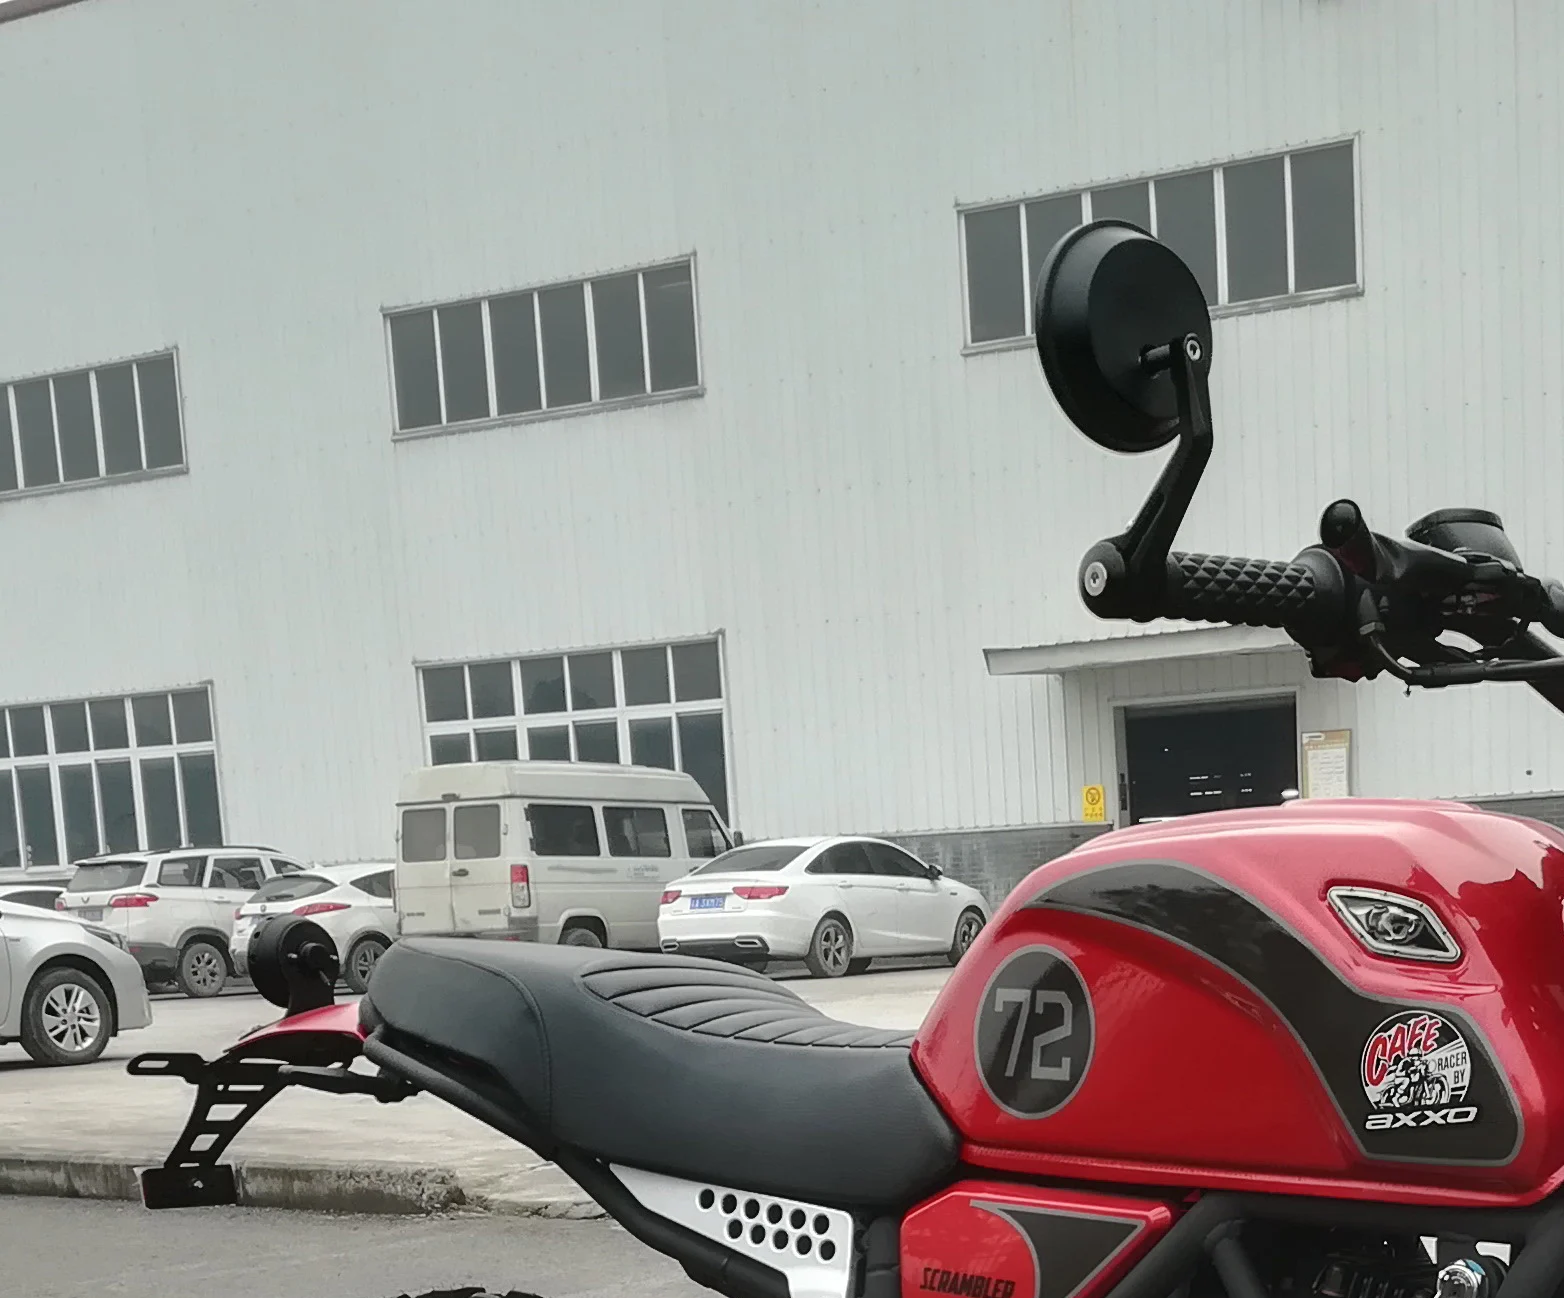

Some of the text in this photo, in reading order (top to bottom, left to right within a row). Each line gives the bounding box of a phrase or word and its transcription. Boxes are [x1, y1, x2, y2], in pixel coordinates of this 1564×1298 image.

[994, 987, 1073, 1081] 72
[1364, 1014, 1442, 1087] CAFE
[1437, 1051, 1468, 1071] RACER
[1453, 1069, 1466, 1085] BY
